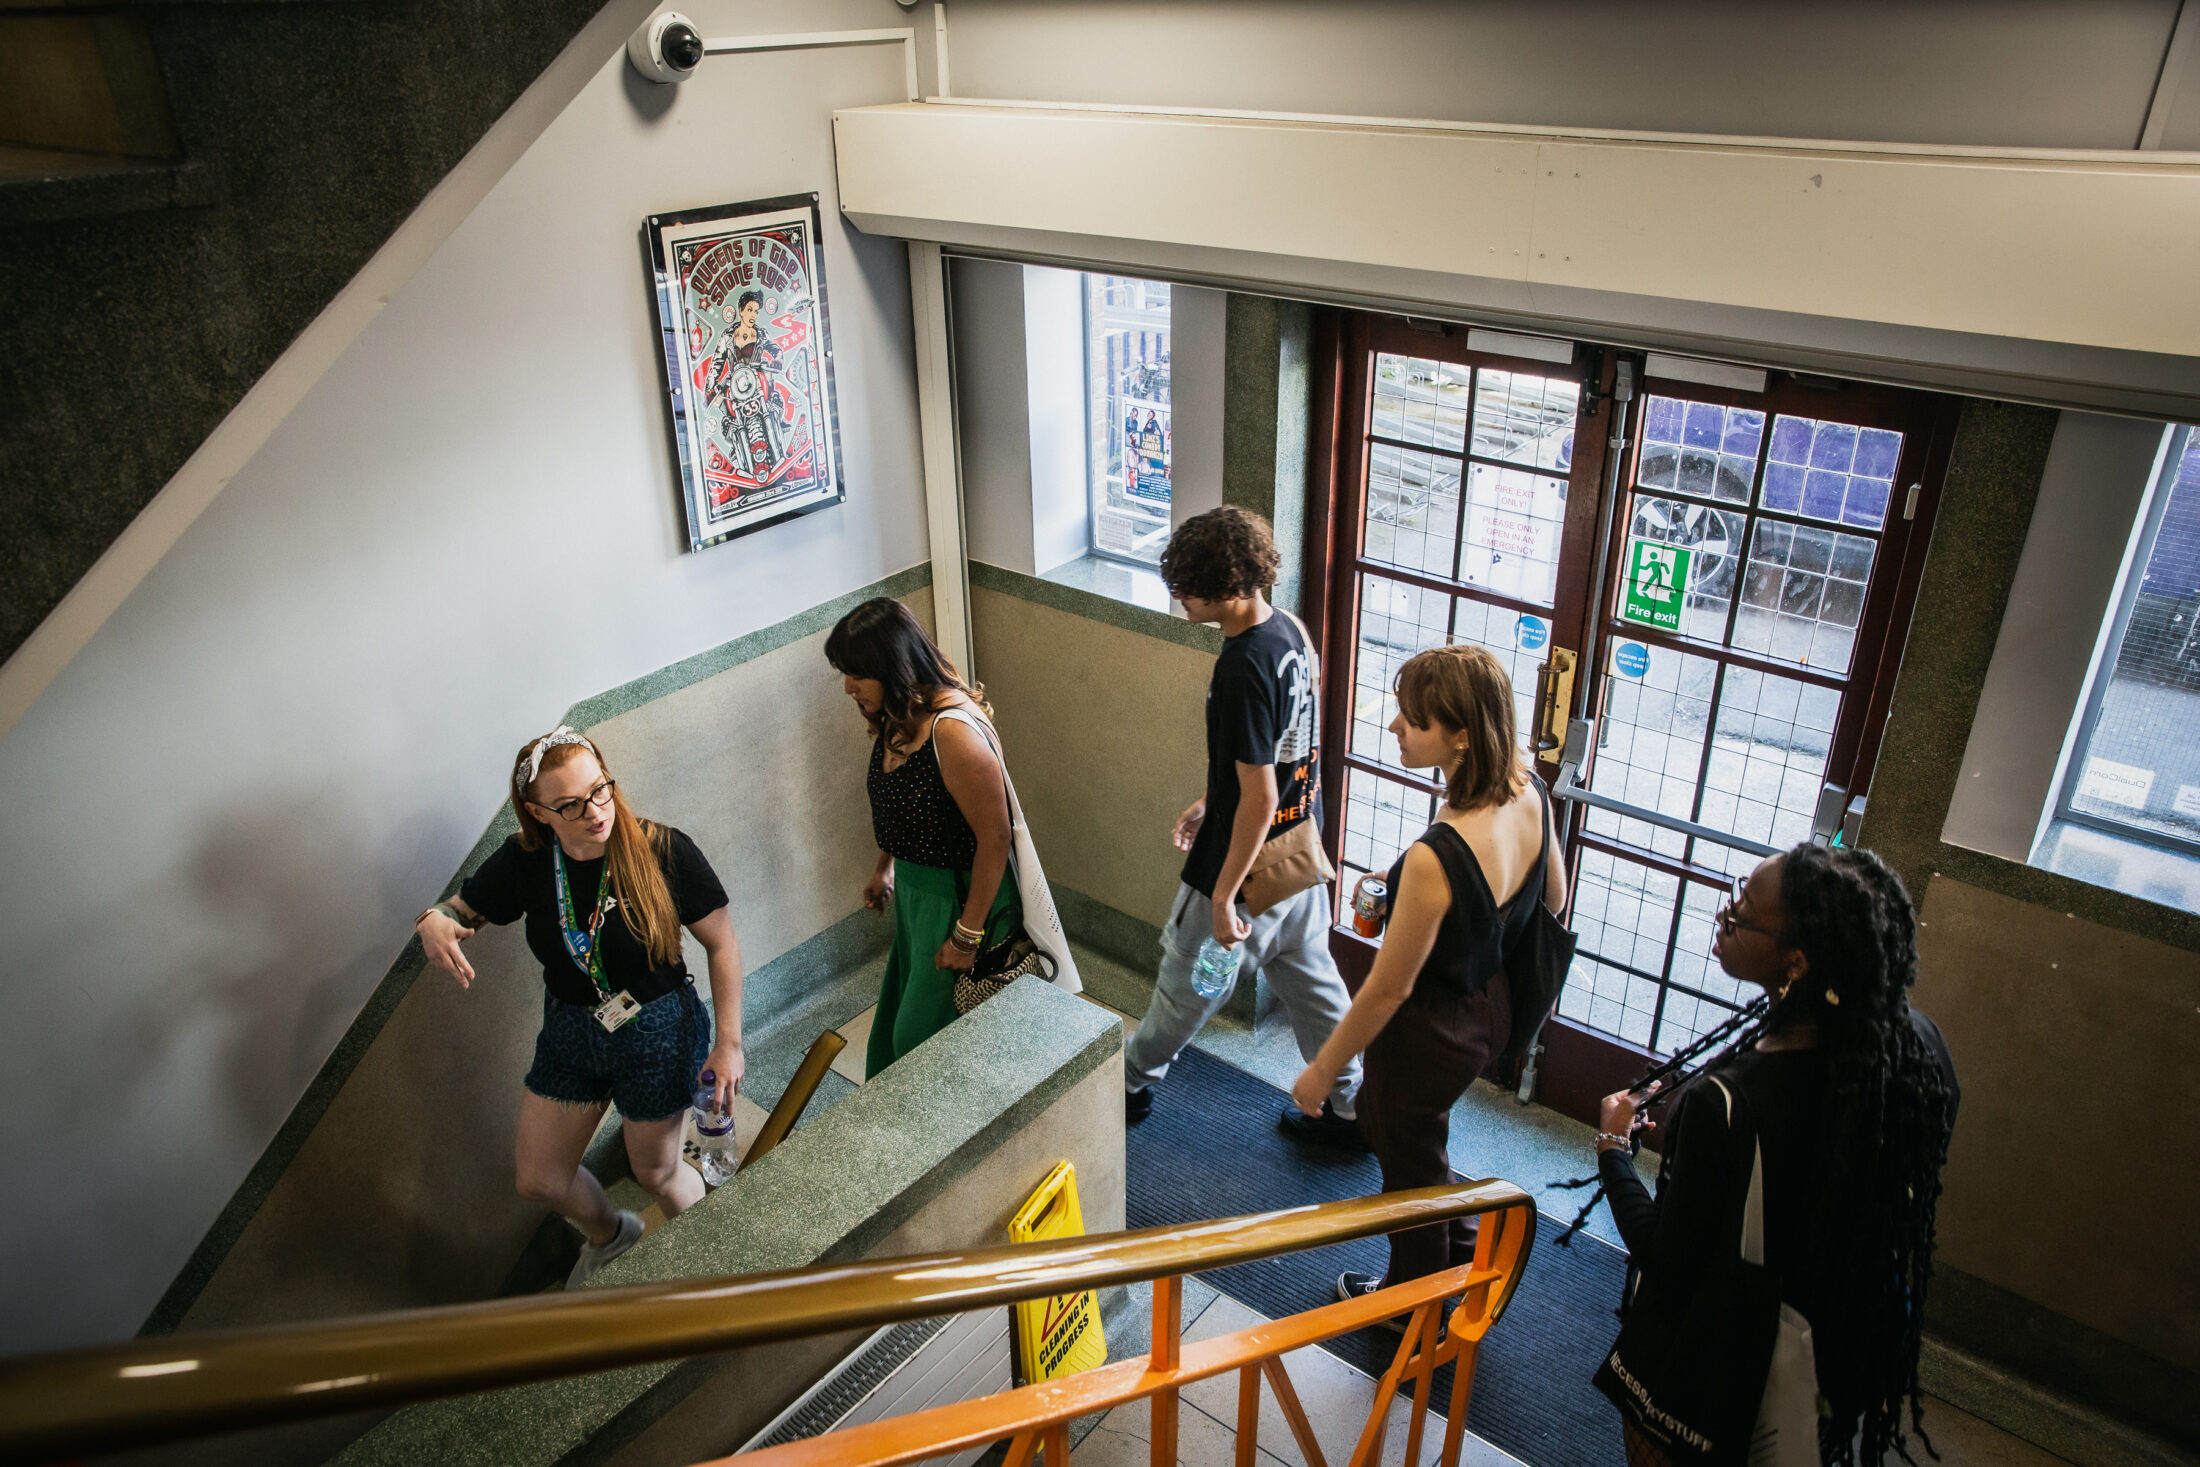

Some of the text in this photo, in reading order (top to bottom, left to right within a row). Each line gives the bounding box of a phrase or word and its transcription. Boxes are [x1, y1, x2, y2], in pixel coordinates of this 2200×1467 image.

[748, 239, 766, 258] OF
[705, 262, 788, 306] STONE AGE
[1494, 484, 1535, 499] FIRE EXIT
[1501, 496, 1527, 508] ONLY!
[1481, 515, 1541, 536] PLEASE ONLY
[1481, 537, 1535, 556] EMERGENCY
[1486, 528, 1535, 545] OPEN IN AN
[1627, 602, 1677, 625] Fire exit
[1039, 1291, 1090, 1366] CLEANING IN
[1044, 1313, 1090, 1379] PROGRESS
